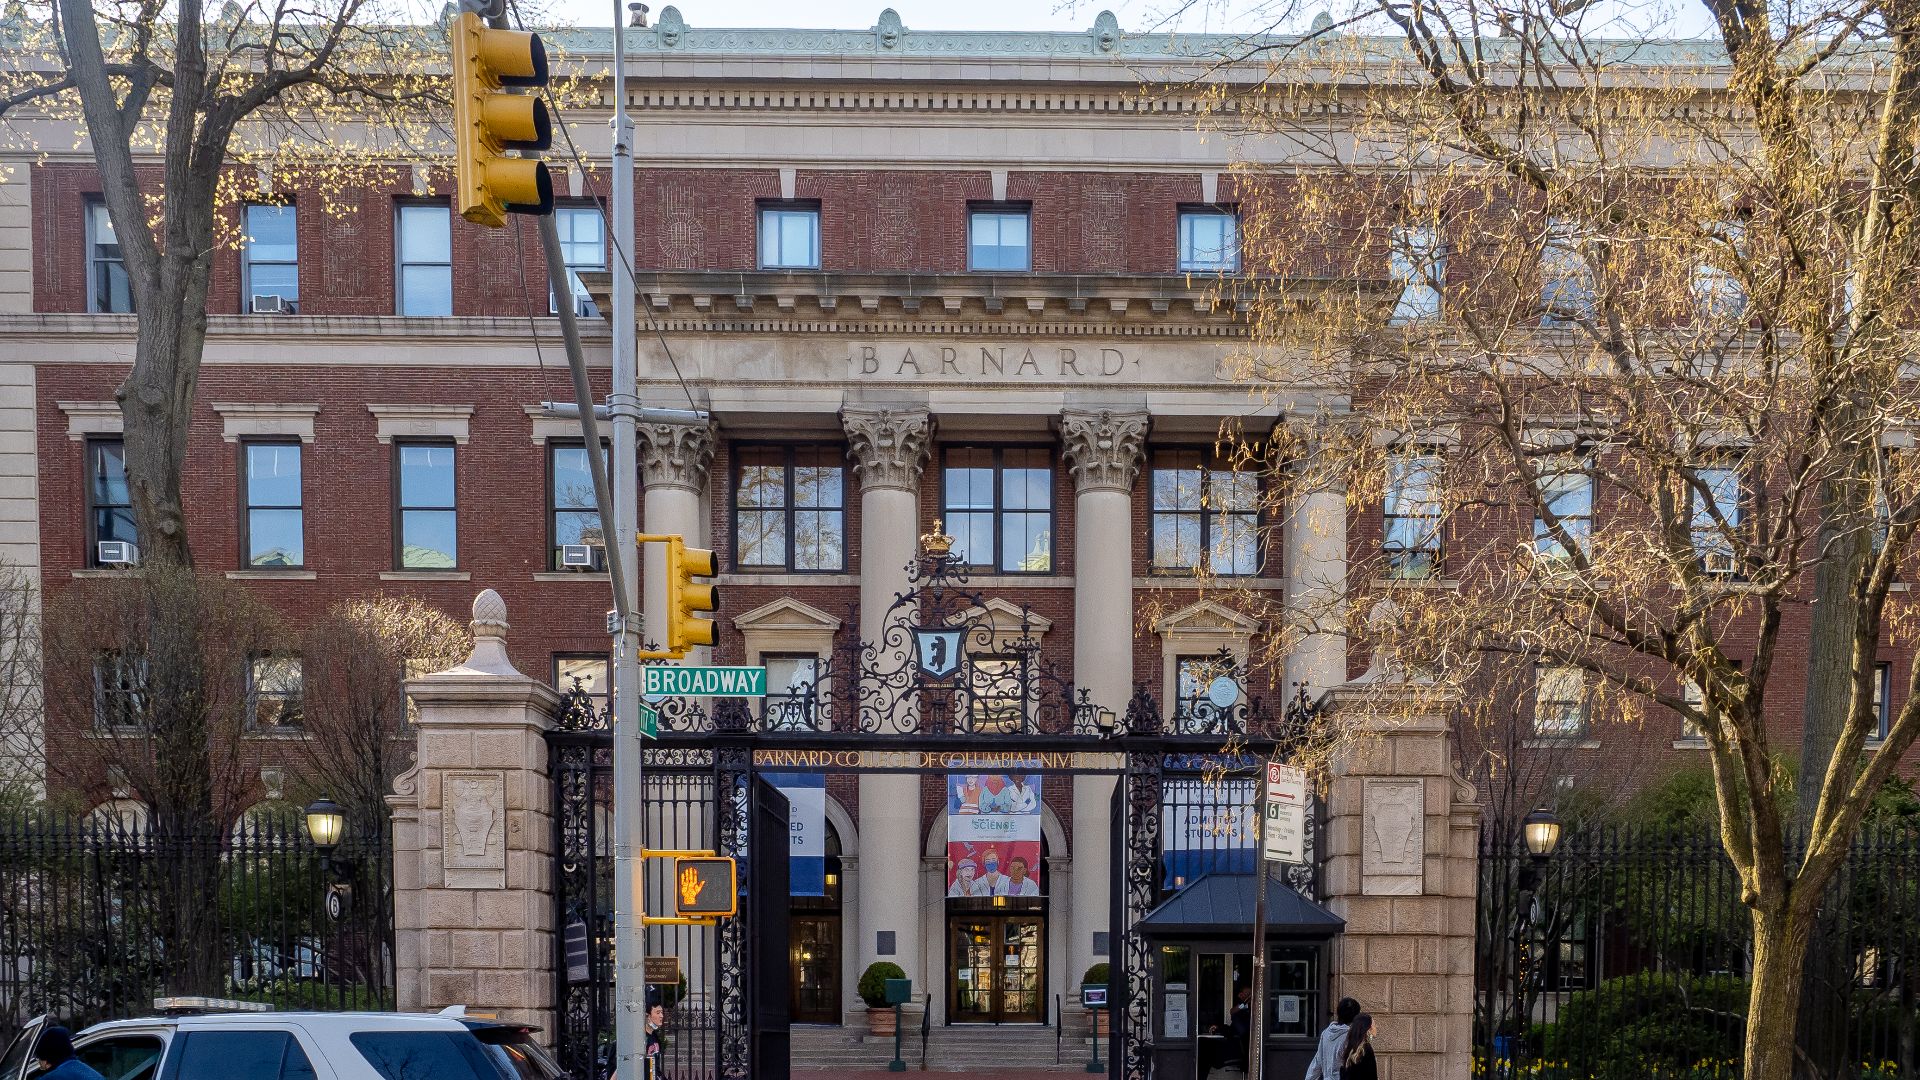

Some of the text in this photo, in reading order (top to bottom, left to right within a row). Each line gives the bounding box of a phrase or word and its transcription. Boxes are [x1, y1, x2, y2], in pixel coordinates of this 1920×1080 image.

[859, 346, 1124, 376] BARNARD
[647, 670, 760, 693] BROADWAY
[753, 750, 1125, 769] BARNARD COLLEGE OF COLUMBIA UNIVERSITY
[1270, 804, 1277, 818] 6
[1184, 828, 1238, 838] STUDNS
